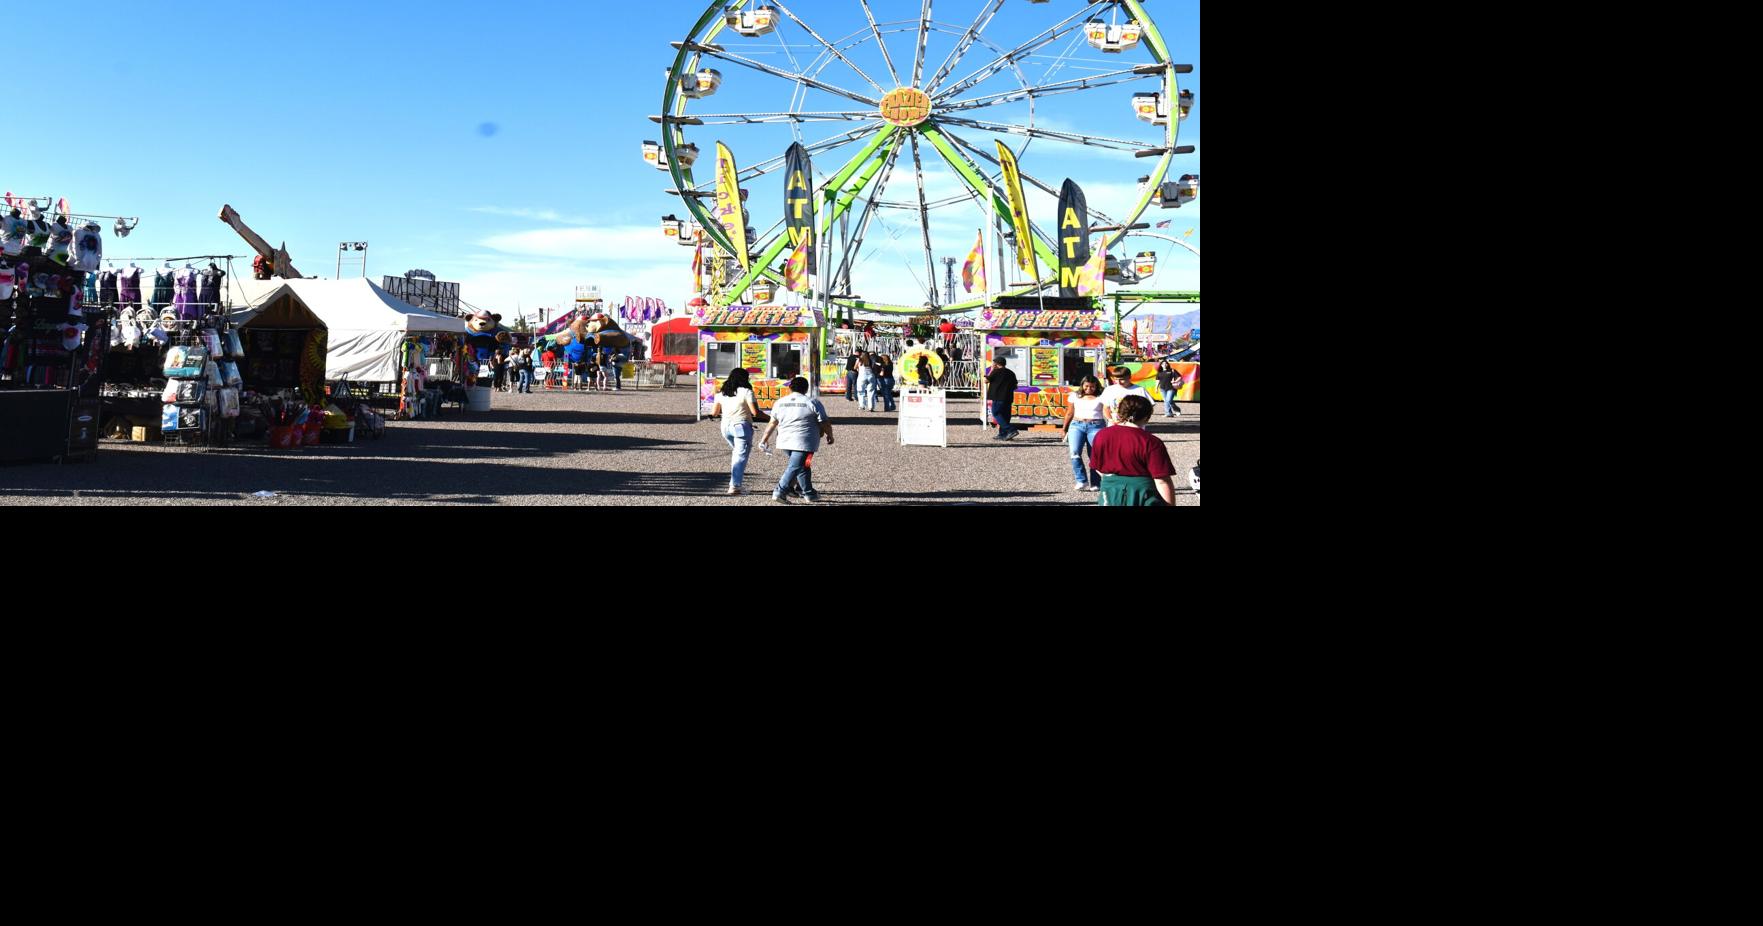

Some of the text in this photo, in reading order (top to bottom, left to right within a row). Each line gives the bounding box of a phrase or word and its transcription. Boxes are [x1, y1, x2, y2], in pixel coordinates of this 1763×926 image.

[787, 170, 812, 247] ATM
[1061, 207, 1083, 289] ATM
[703, 309, 800, 326] TICKETS
[991, 310, 1096, 329] TICKETS
